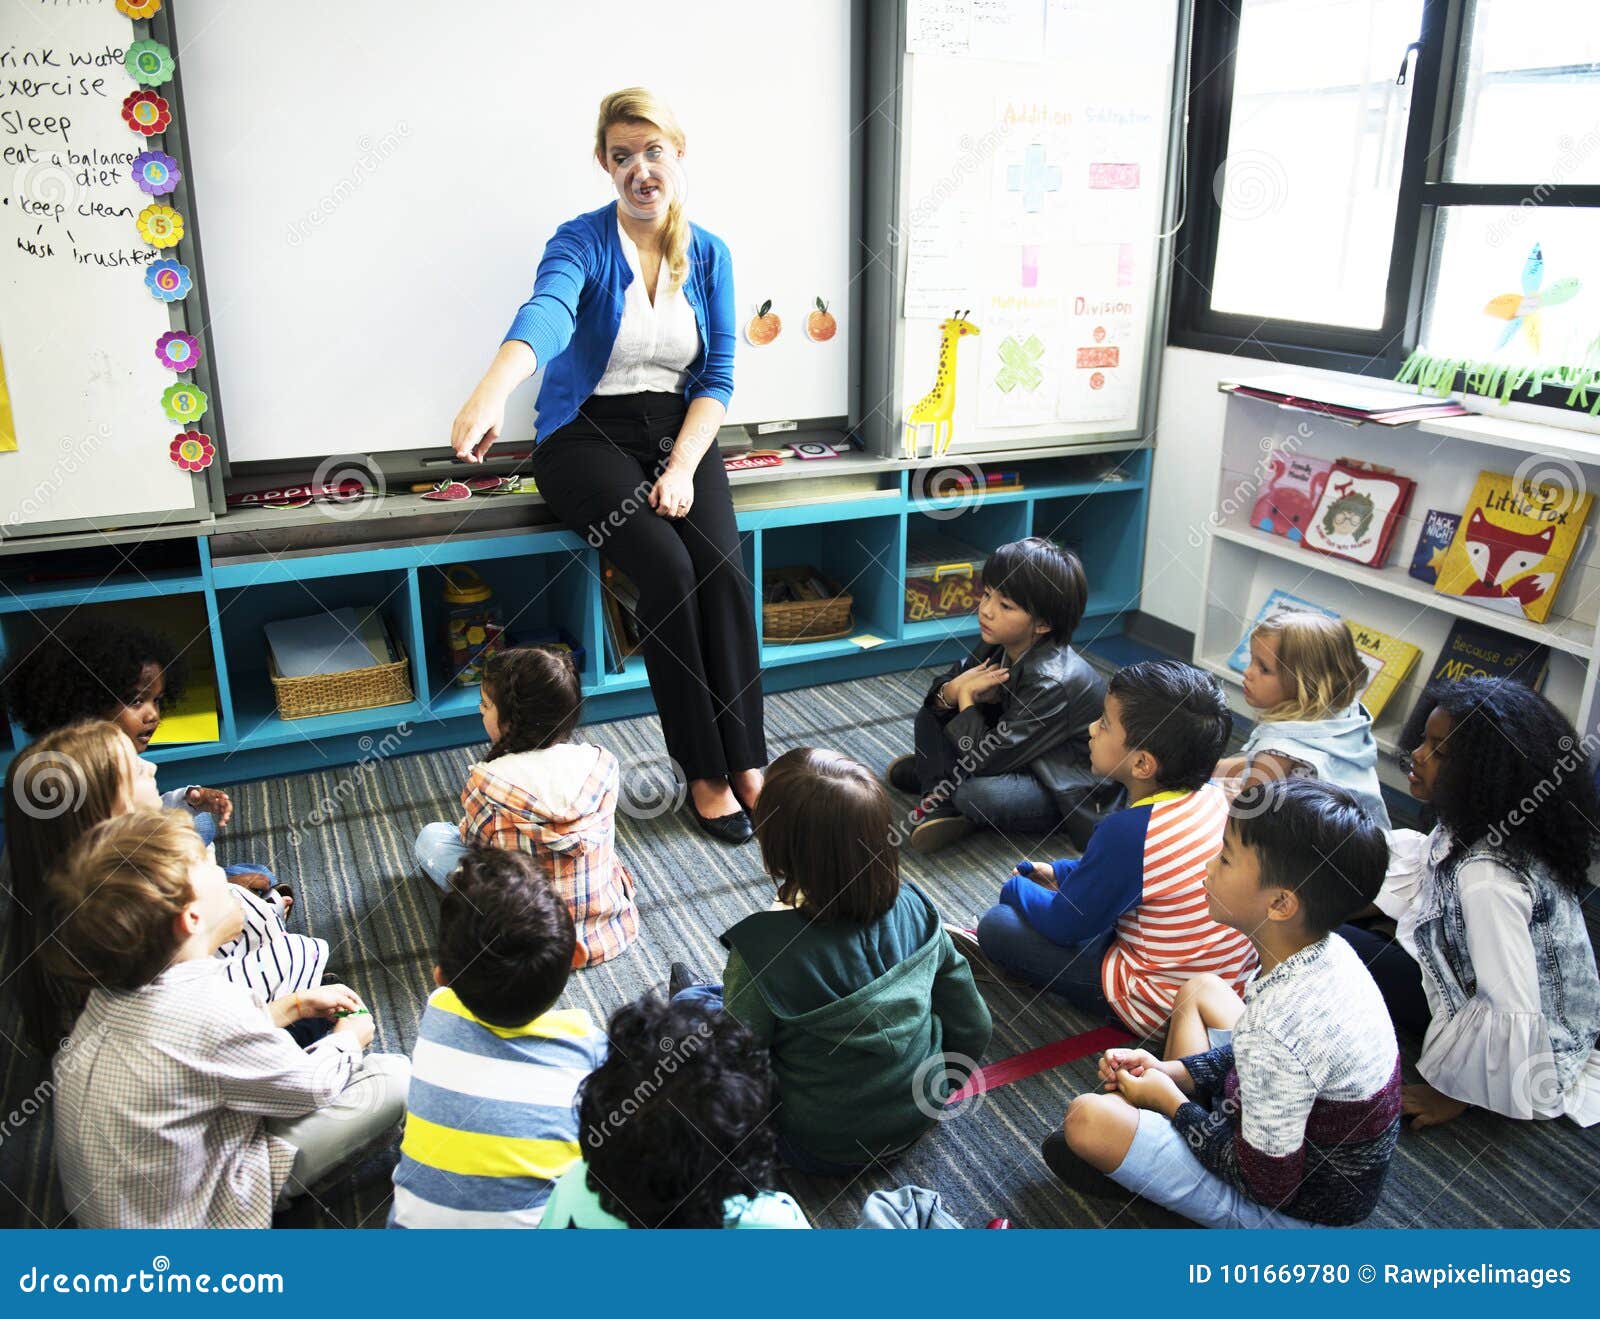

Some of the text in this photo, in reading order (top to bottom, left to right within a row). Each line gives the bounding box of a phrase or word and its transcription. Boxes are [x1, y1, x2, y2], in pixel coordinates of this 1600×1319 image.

[0, 46, 126, 67] rink wate
[143, 54, 157, 72] 2
[0, 75, 107, 98] xercise
[140, 103, 152, 121] 3
[1003, 102, 1073, 126] Addition
[3, 144, 40, 165] eat
[51, 153, 63, 167] a
[76, 168, 122, 187] diet
[149, 164, 162, 180] 4
[20, 195, 134, 223] keep clean
[155, 218, 167, 234] 5
[161, 271, 174, 288] 6
[1073, 295, 1133, 317] Division
[171, 343, 183, 359] 7
[178, 394, 190, 411] 8
[185, 444, 198, 460] 9
[1485, 489, 1569, 525] Little Fox
[1428, 511, 1456, 531] MAGIC
[1452, 634, 1524, 668] Because of
